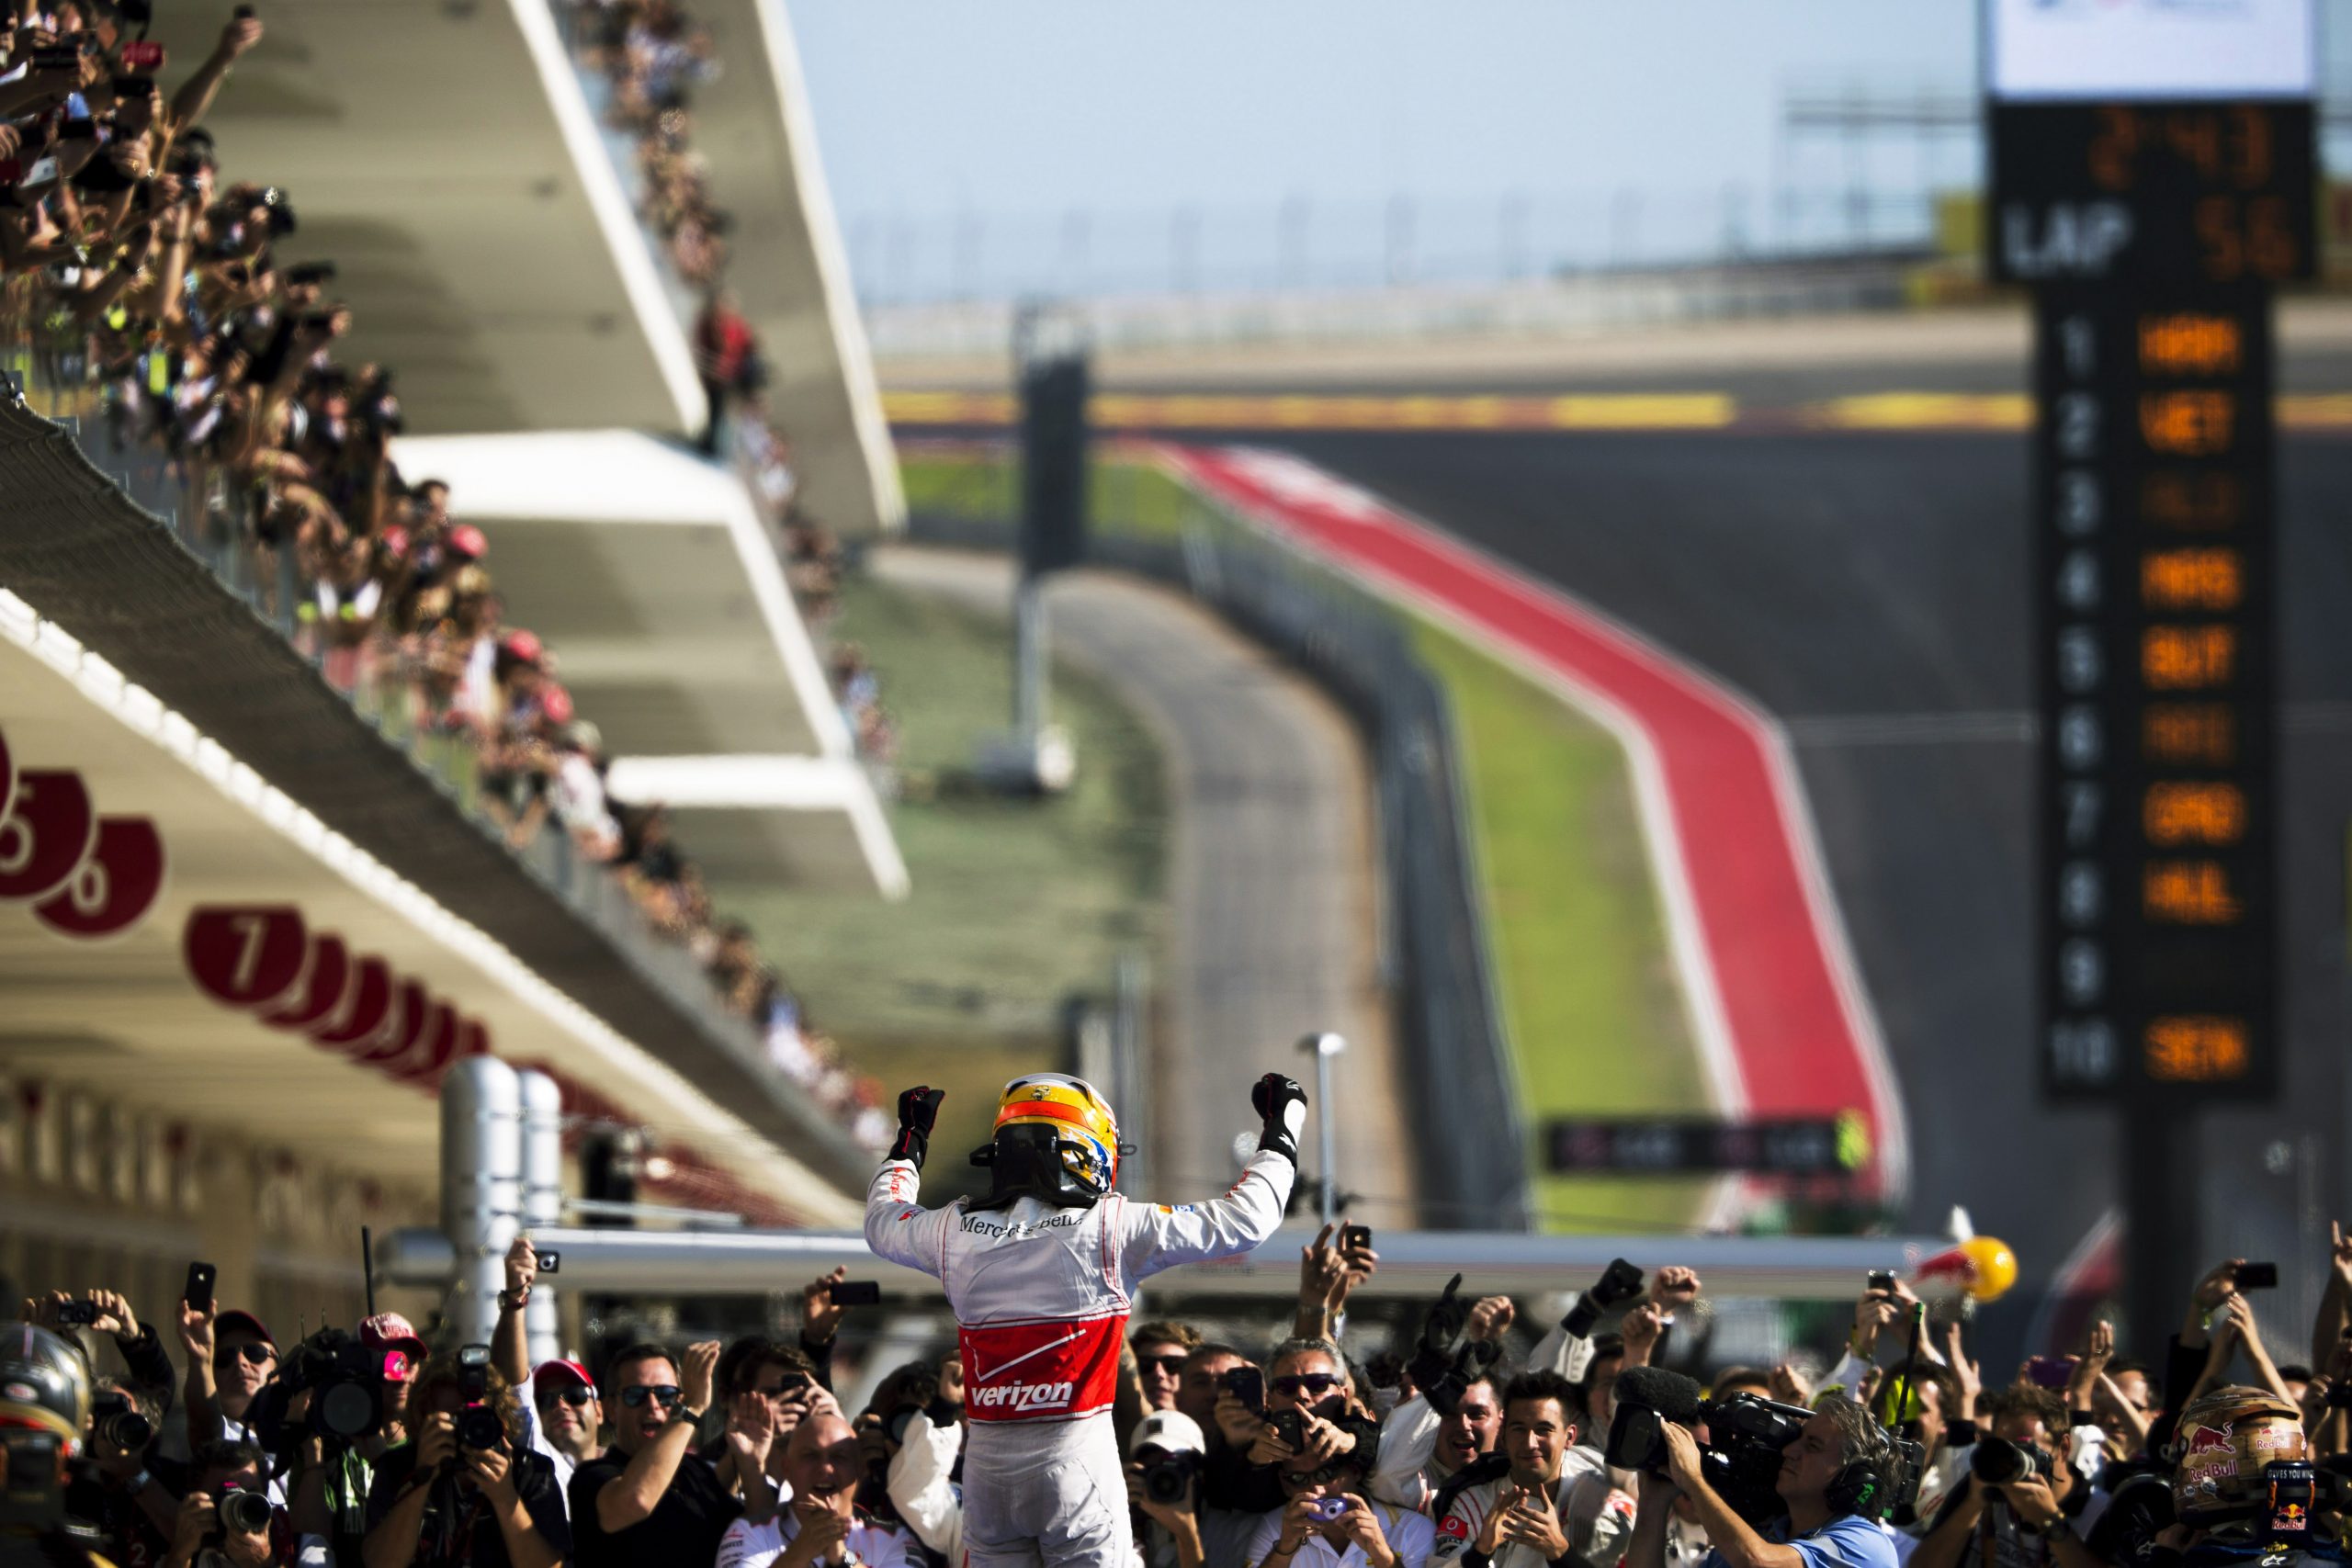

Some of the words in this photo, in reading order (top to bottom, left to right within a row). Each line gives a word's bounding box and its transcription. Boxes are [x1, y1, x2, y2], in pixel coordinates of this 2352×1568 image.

[2004, 201, 2133, 275] LAP
[2064, 317, 2095, 375] 1
[2059, 393, 2099, 455] 2
[2141, 391, 2234, 455] VET
[2058, 472, 2100, 533] 3
[2058, 551, 2099, 608] 4
[2059, 626, 2100, 693] 5
[2143, 625, 2235, 689] BUT
[2060, 705, 2100, 769] 6
[2063, 782, 2101, 847] 7
[2061, 862, 2101, 924] 8
[231, 917, 266, 993] 7
[2061, 939, 2102, 1003] 9
[2052, 1020, 2116, 1084] 10
[2146, 1017, 2247, 1081] SEN
[959, 1213, 1083, 1238] Mercds-Benz
[971, 1380, 1073, 1411] verizon
[2189, 1462, 2211, 1483] Red
[2211, 1459, 2238, 1477] Bull
[2256, 1438, 2274, 1450] Red
[2267, 1470, 2287, 1479] GIVES
[2288, 1470, 2301, 1479] YOU
[2272, 1518, 2291, 1530] Red
[2291, 1517, 2306, 1530] Bull
